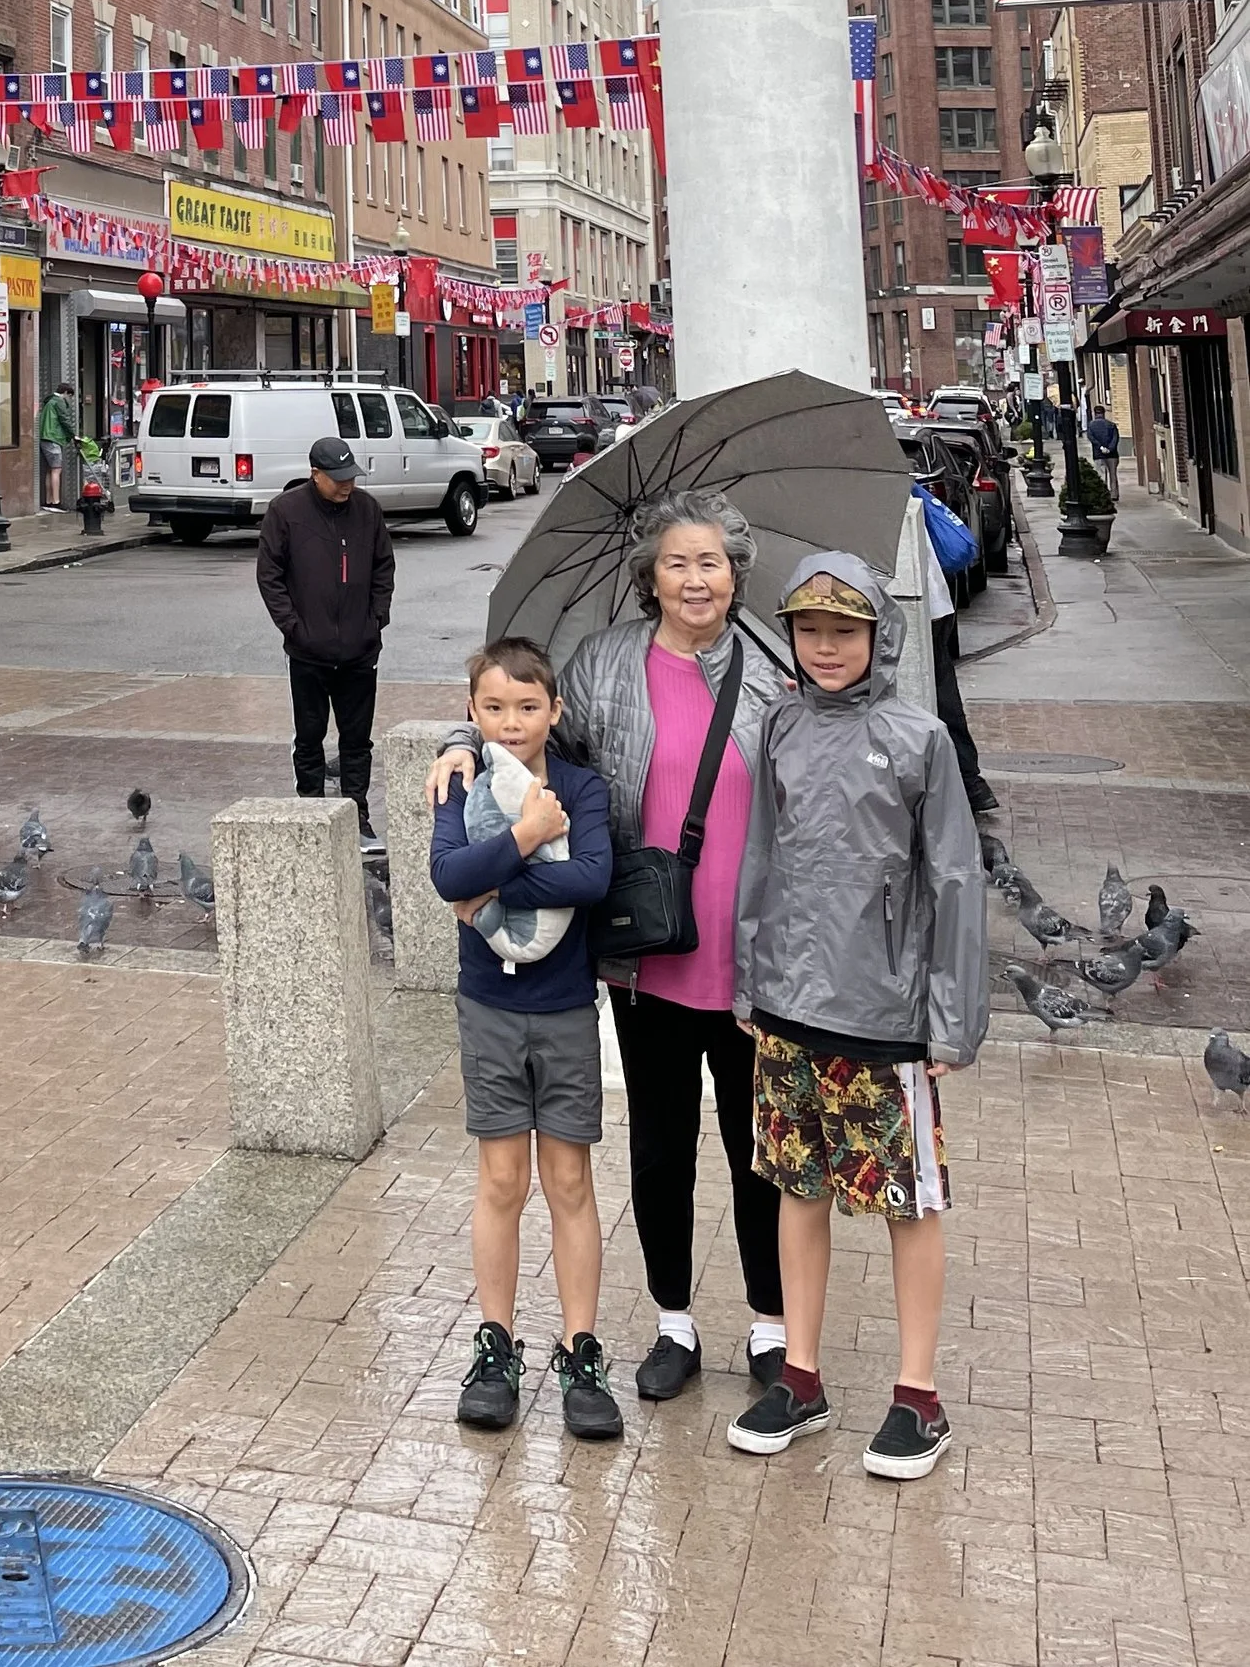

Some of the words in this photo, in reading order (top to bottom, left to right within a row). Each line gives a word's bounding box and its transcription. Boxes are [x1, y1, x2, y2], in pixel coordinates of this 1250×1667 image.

[176, 195, 216, 225] GREAT
[220, 205, 251, 233] TASTE
[7, 277, 37, 297] PASTRY
[1145, 315, 1209, 334] 新金門
